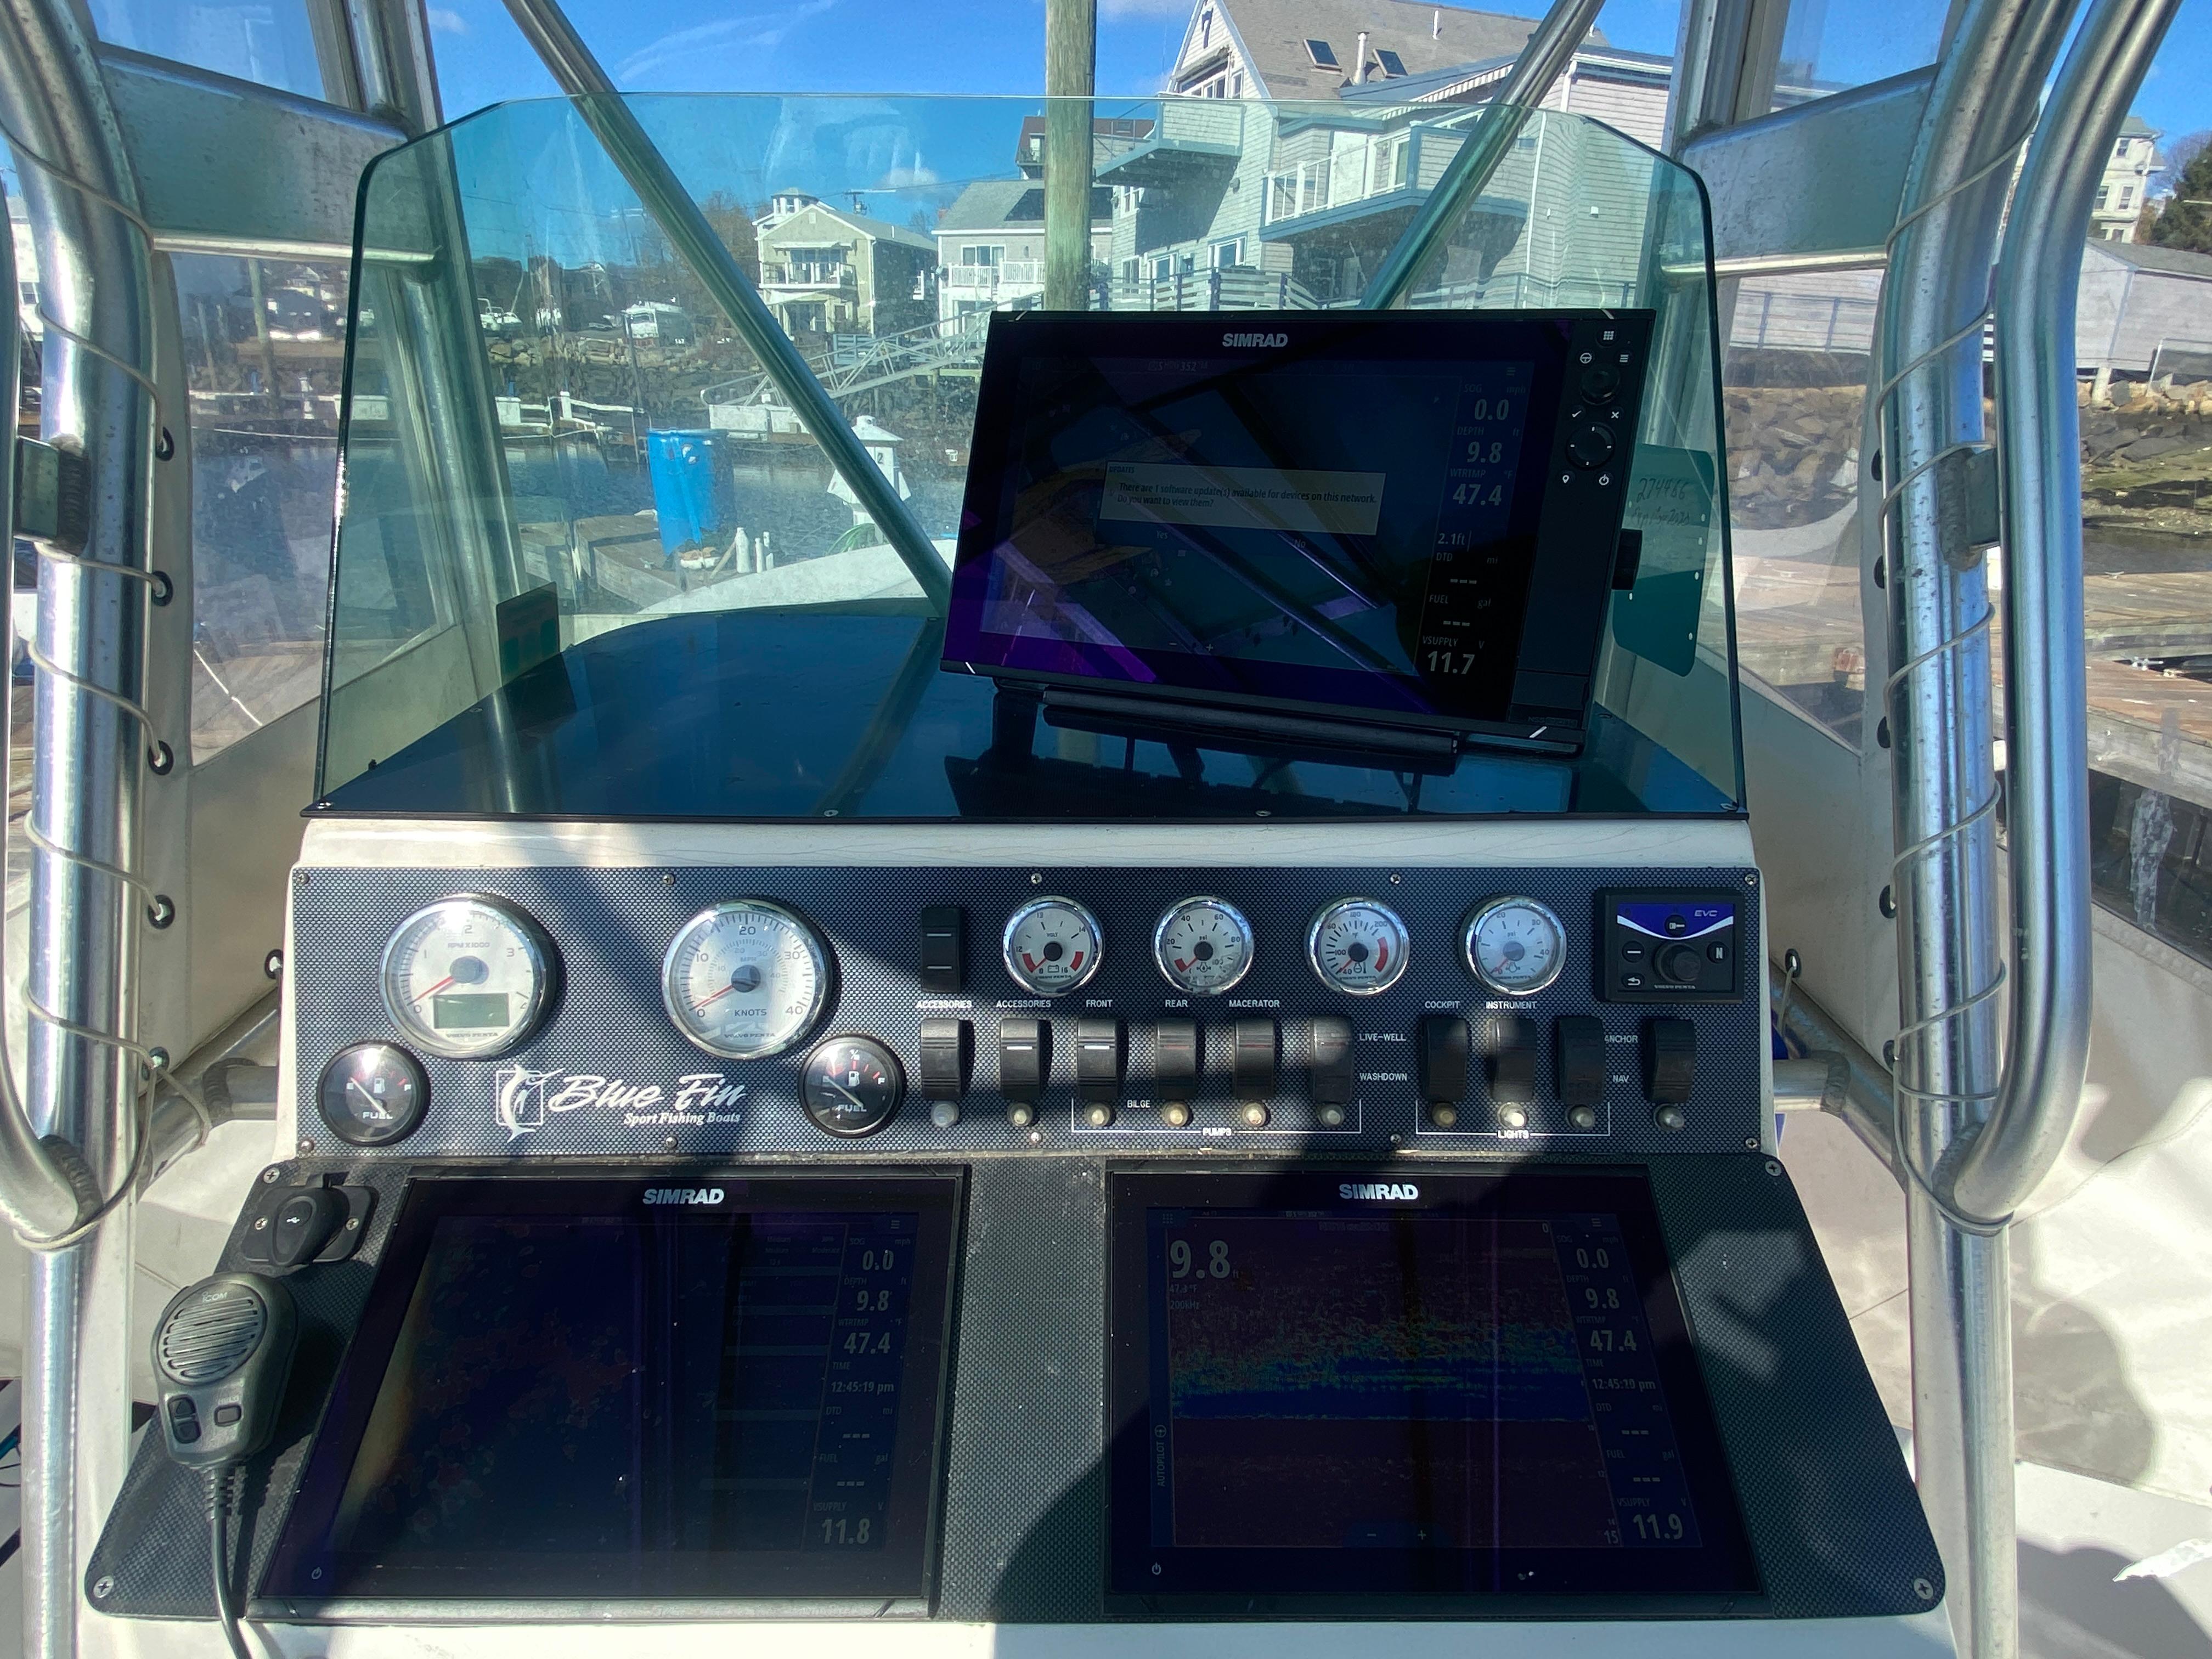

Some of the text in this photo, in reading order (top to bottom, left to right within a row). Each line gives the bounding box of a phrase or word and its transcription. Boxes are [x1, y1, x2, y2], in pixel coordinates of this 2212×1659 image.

[1222, 333, 1288, 347] SIMRAD
[1464, 384, 1481, 393] SOG
[1474, 399, 1509, 420] 0.0
[1457, 426, 1485, 436] DEPTH
[1466, 441, 1503, 464] 9.8
[878, 453, 883, 464] 2
[1451, 468, 1486, 478] WTRTMP
[1119, 483, 1139, 492] There
[1160, 485, 1193, 495] software
[1194, 486, 1230, 499] update(s)
[1233, 488, 1266, 498] available
[1267, 489, 1279, 499] for
[1280, 490, 1310, 500] devices
[1324, 493, 1339, 501] this
[1340, 493, 1376, 503] network.
[1453, 483, 1502, 506] 47.4
[1128, 497, 1142, 505] you
[1143, 496, 1162, 505] want
[1190, 499, 1214, 507] them?
[1156, 531, 1168, 539] Yes
[1295, 539, 1306, 549] No
[1436, 552, 1498, 565] DTD mi
[1429, 594, 1492, 609] FUEL gal
[1423, 636, 1485, 649] VSUPPLY V
[1427, 651, 1475, 674] 11.7
[465, 925, 472, 934] 2
[739, 926, 756, 935] 20
[424, 950, 427, 958] 1
[507, 948, 515, 957] 3
[697, 953, 709, 962] 10
[1716, 947, 1723, 958] N
[414, 1005, 422, 1013] 0
[916, 1000, 972, 1008] ACCESSORIES
[1425, 1001, 1460, 1009] COCKPIT
[697, 1009, 706, 1018] 0
[735, 1008, 767, 1017] KNOTS
[785, 1006, 803, 1015] 40
[1604, 1035, 1638, 1043] ANCHOR
[1359, 1073, 1407, 1081] WASHDOWN
[1613, 1075, 1629, 1083] NAV
[549, 1073, 746, 1112] Blue Fin
[836, 1104, 867, 1113] FUEL
[624, 1112, 741, 1127] Sport Fishing Boats
[1203, 1127, 1232, 1136] PUMPS
[1498, 1130, 1529, 1139] LIGHTS
[642, 1188, 724, 1204] SIMRAD
[1339, 1183, 1418, 1200] SIMRAD
[1602, 1237, 1618, 1245] mph
[862, 1250, 894, 1271] 0.0
[1170, 1240, 1231, 1279] 9.8
[1576, 1248, 1609, 1268] 0.0
[844, 1277, 867, 1285] DEPTH
[856, 1290, 889, 1311] 9.8
[1585, 1288, 1620, 1309] 9.8
[1170, 1300, 1200, 1310] 200kHz
[843, 1332, 891, 1354] 47.4
[1590, 1330, 1637, 1351] 47.4
[833, 1362, 850, 1370] TIME
[1585, 1359, 1604, 1367] TIME
[831, 1381, 895, 1395] 12:45:19 pm
[1592, 1379, 1656, 1392] 12:45:20 pm
[826, 1407, 842, 1415] DTD
[1596, 1403, 1612, 1412] DTD
[819, 1453, 888, 1465] FUEL gal
[1606, 1449, 1674, 1462] FUEL gal
[1156, 1441, 1166, 1487] AUTOPILOT
[813, 1502, 883, 1511] VSUPPLY V
[1617, 1498, 1687, 1507] VSUPPLY V
[822, 1518, 870, 1544] 11.8
[1633, 1514, 1683, 1539] 11.9
[1604, 1530, 1618, 1544] 15
